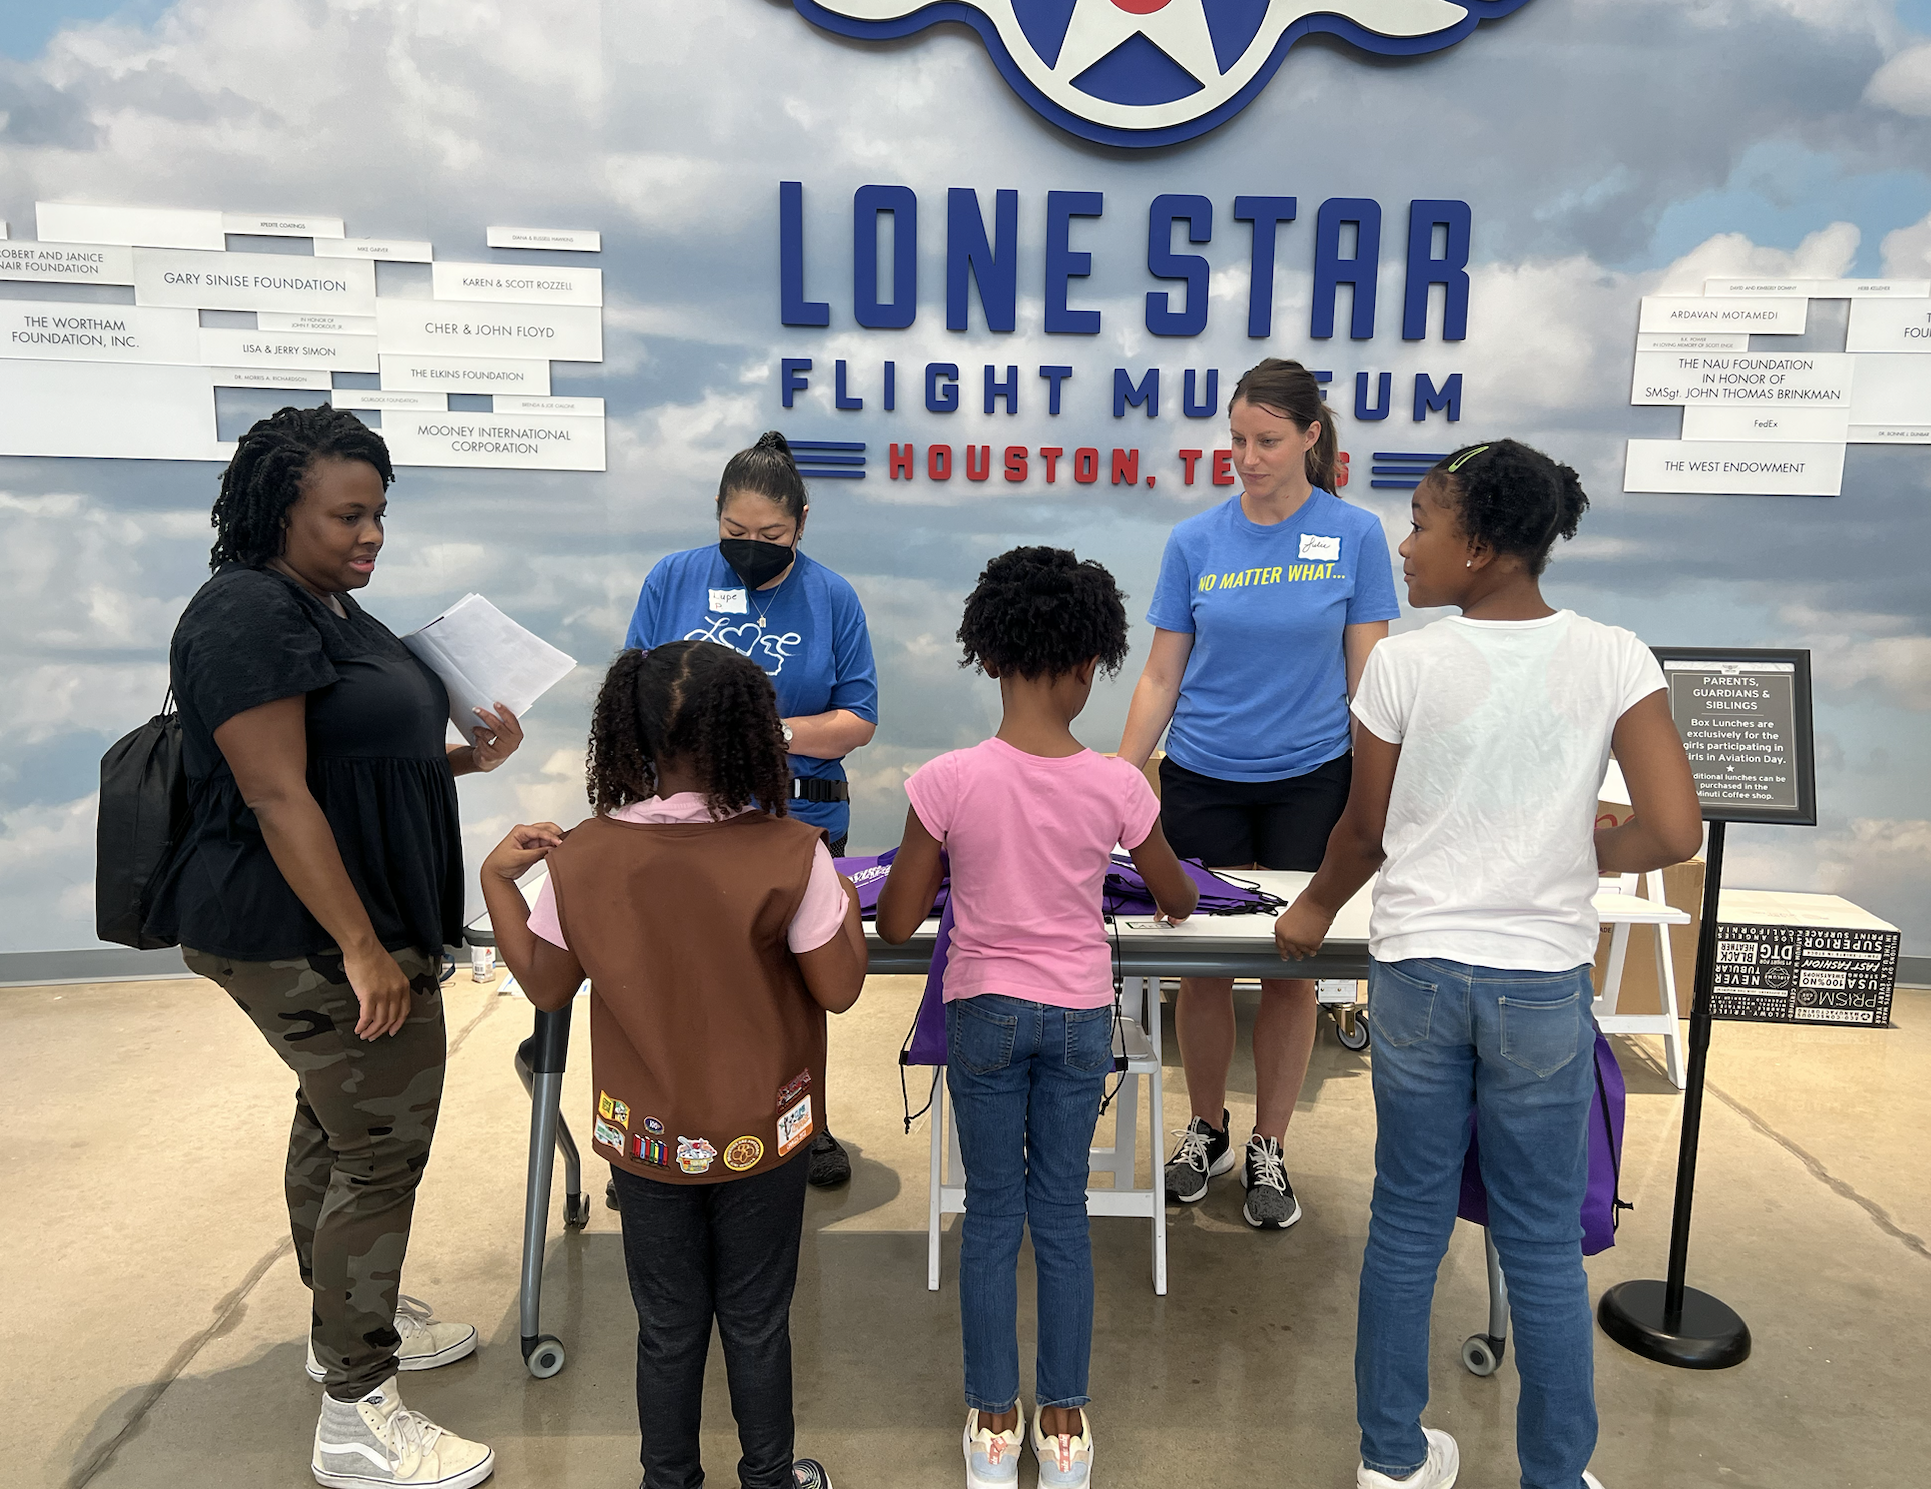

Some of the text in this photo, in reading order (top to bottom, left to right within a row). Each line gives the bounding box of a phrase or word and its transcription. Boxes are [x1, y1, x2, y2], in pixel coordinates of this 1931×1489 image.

[38, 251, 62, 260] AND
[66, 253, 103, 262] JANICE
[779, 181, 1471, 341] LONE STAR
[26, 262, 98, 273] FOUNDATION
[164, 273, 347, 292] GARY SINISE FOUNDATION
[462, 278, 572, 290] KAREN & SCOTT ROZZELL
[1670, 311, 1778, 320] ARDAVAN MOTAMEDI
[24, 316, 125, 331] THE WORTHAM
[425, 323, 554, 338] CHER & JOHN FLOYD
[12, 332, 139, 348] FOUNDATION, INC.
[243, 344, 336, 356] LISA & JERRY SIMON
[1679, 359, 1813, 370] THE NAU FOUNDATION
[411, 369, 523, 380] THE ELKINS FOUNDATION
[1703, 374, 1785, 384] IN HONOR OF
[781, 358, 1463, 422] FLIGHT MUUM
[1646, 387, 1840, 400] SMSgt. JOHN THOMAS BRINKMAN
[1754, 420, 1778, 428] FedEx
[418, 426, 570, 441] MOONEY INTERNATIONAL
[452, 441, 538, 454] CORPORATION
[889, 442, 1350, 489] HOUSTON, TES
[1665, 461, 1805, 473] THE WEST ENDOWMENT
[1198, 563, 1345, 592] NO MATTER WHAT...
[713, 592, 737, 603] Lupe
[1704, 678, 1759, 687] PARENTS,
[1693, 689, 1759, 698] GUARDIANS
[1706, 702, 1757, 710] SIBLINGS
[1691, 719, 1709, 727] Box
[1713, 719, 1754, 728] Lunches
[1687, 731, 1779, 740] exclusively for the
[1683, 742, 1784, 753] girls participating in
[1718, 754, 1761, 762] Aviation
[1764, 755, 1787, 765] Day.
[1722, 791, 1750, 799] Coffee
[1752, 793, 1774, 801] shop.
[1717, 932, 1767, 940] ANGELES
[1718, 926, 1794, 936] CALIFORNIA
[1805, 930, 1849, 939] SURFACE
[1721, 943, 1754, 952] HEATHER
[1804, 937, 1882, 951] SUPERIOR
[1720, 951, 1753, 962] BLACK
[1760, 944, 1792, 960] DTG
[1715, 965, 1760, 974] TUBULAR
[1801, 959, 1880, 972] FAST FASHION
[1715, 974, 1760, 985] NEVER
[1847, 979, 1878, 990] USA
[1819, 991, 1877, 1007] PRISM
[1878, 983, 1887, 1004] EVERY
[1875, 1007, 1883, 1024] YEAR
